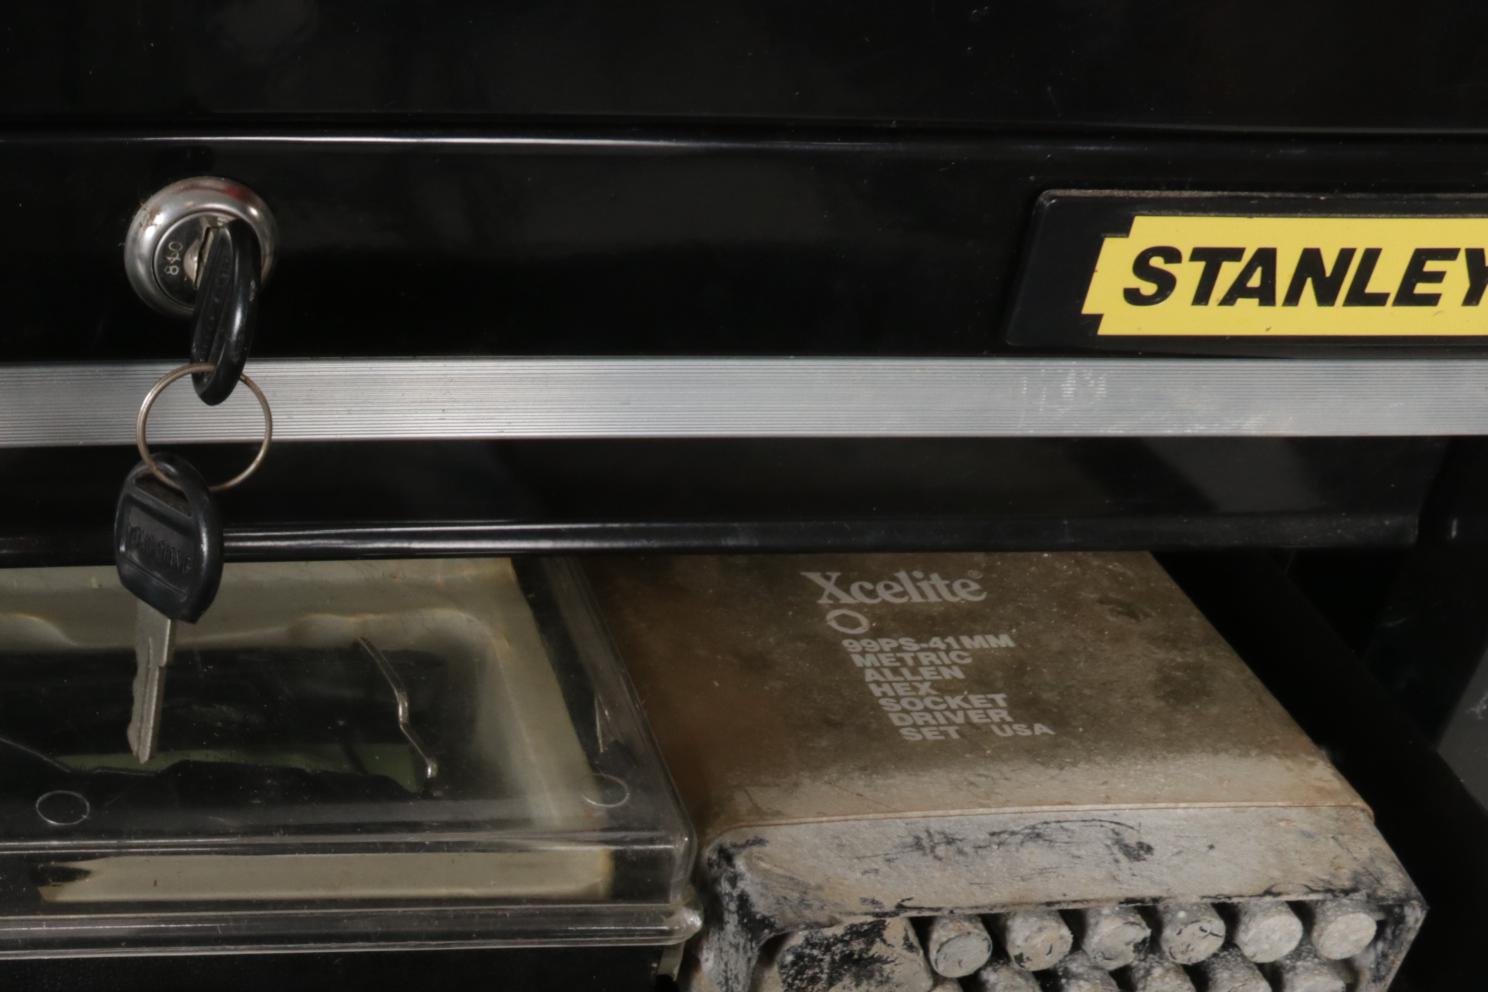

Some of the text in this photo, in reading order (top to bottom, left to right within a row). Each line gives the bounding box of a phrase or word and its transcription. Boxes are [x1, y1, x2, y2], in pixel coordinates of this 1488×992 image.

[1122, 246, 1488, 307] STANLEY
[800, 569, 987, 605] Xcelite
[842, 634, 1016, 652] 99PS-41MM
[850, 650, 973, 668] METRIC
[864, 665, 965, 682] ALLEN
[868, 681, 939, 697] HEX
[878, 693, 1008, 712] SOCKET
[888, 709, 1013, 726] DRIVER
[899, 722, 1056, 741] SET USA
